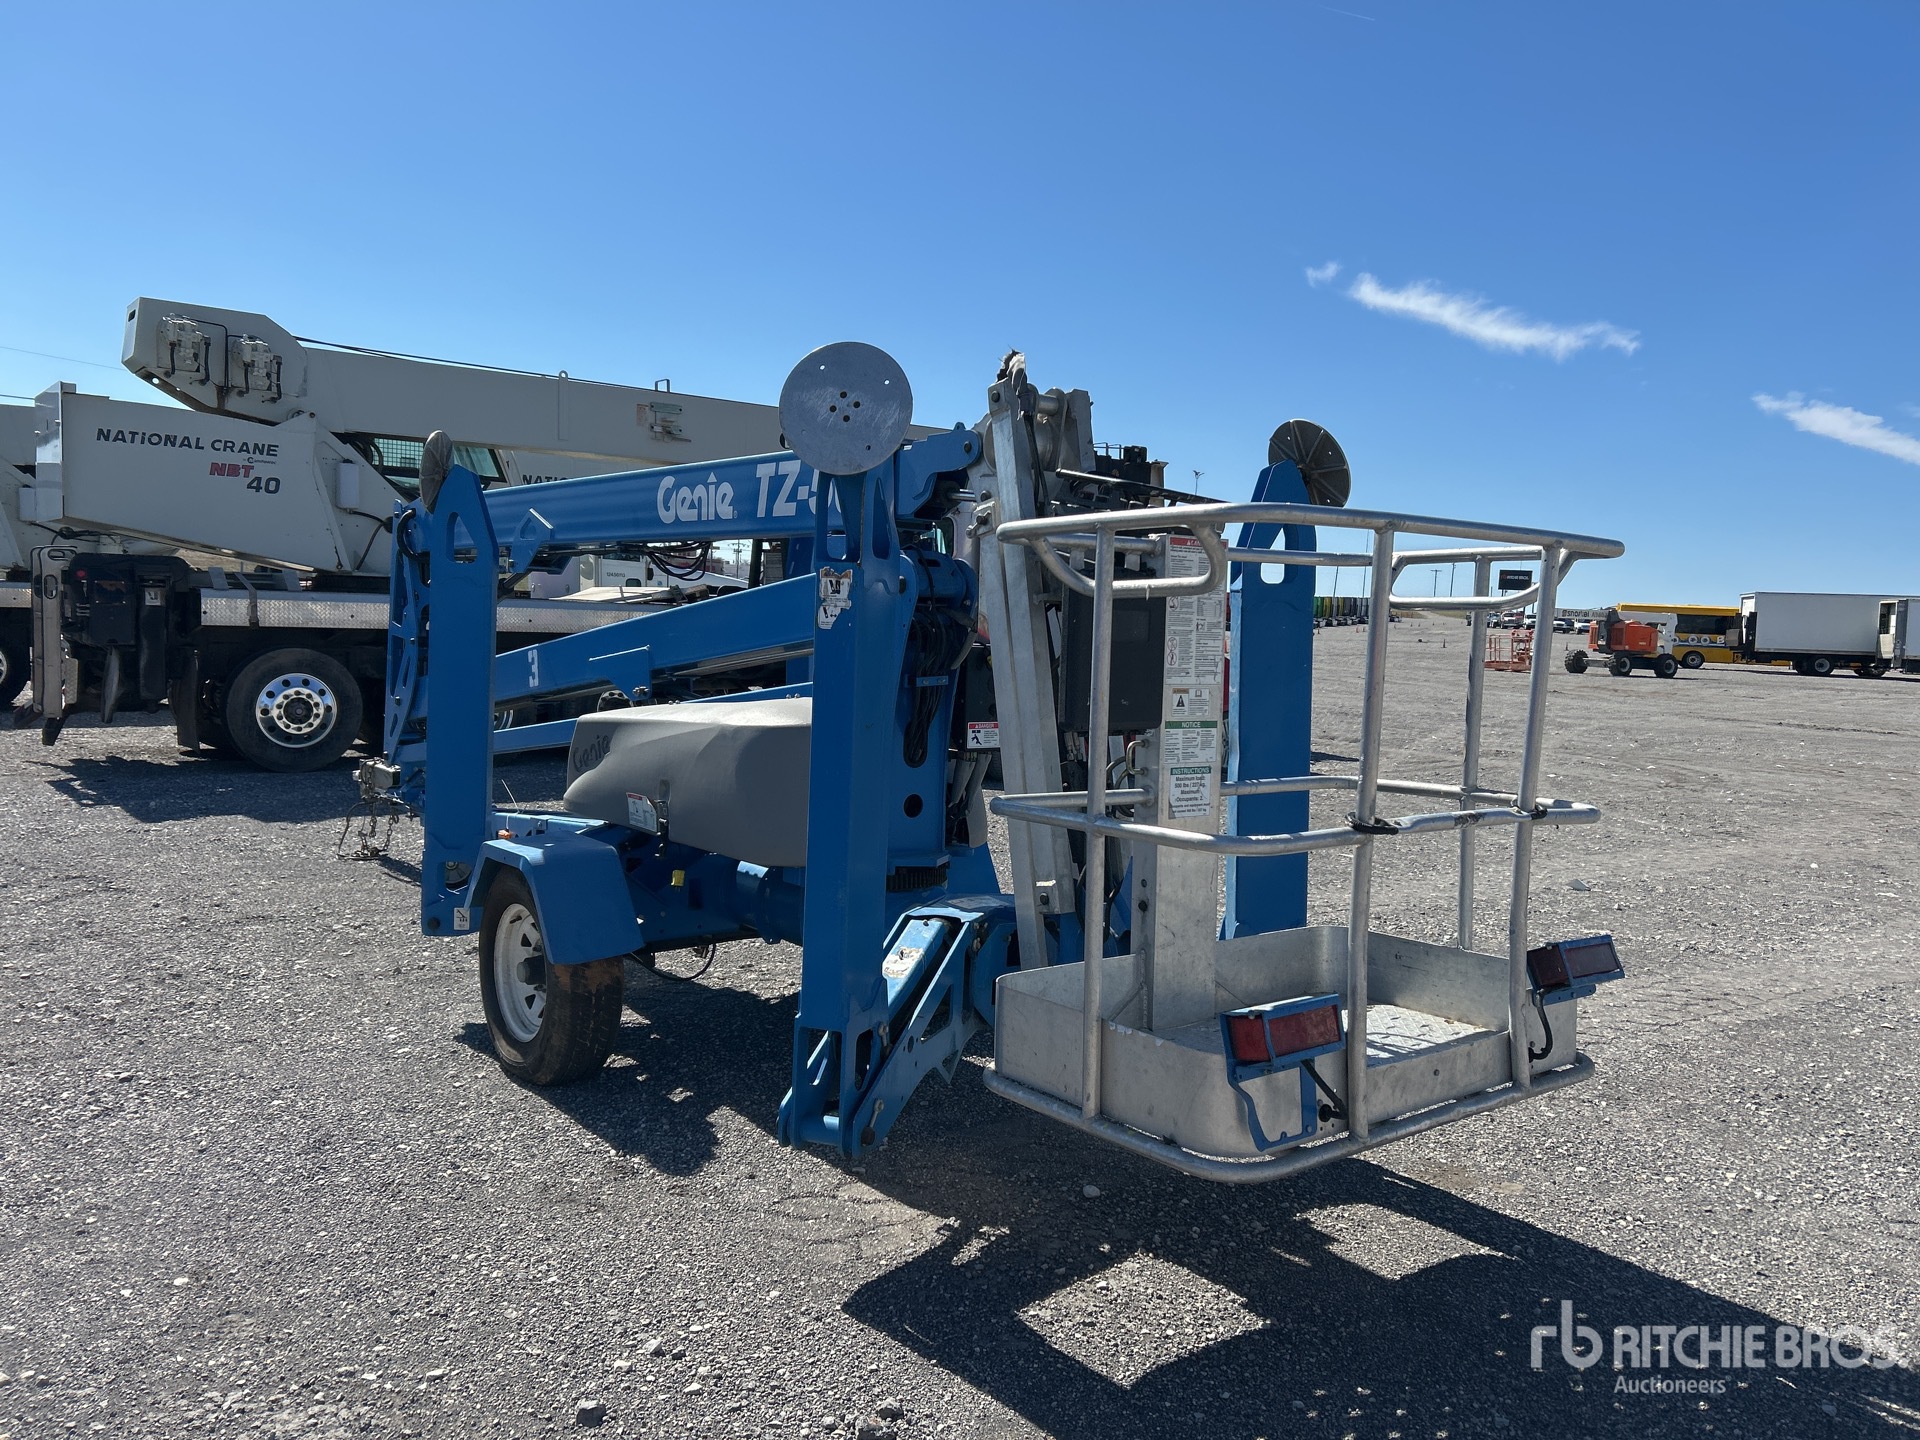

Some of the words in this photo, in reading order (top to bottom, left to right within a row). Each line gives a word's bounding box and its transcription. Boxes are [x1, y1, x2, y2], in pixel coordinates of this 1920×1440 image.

[210, 439, 279, 457] CRANE
[209, 462, 255, 479] NBT
[246, 476, 281, 495] 40
[657, 472, 733, 524] Genie
[527, 649, 539, 688] 3
[572, 734, 611, 773] Genie
